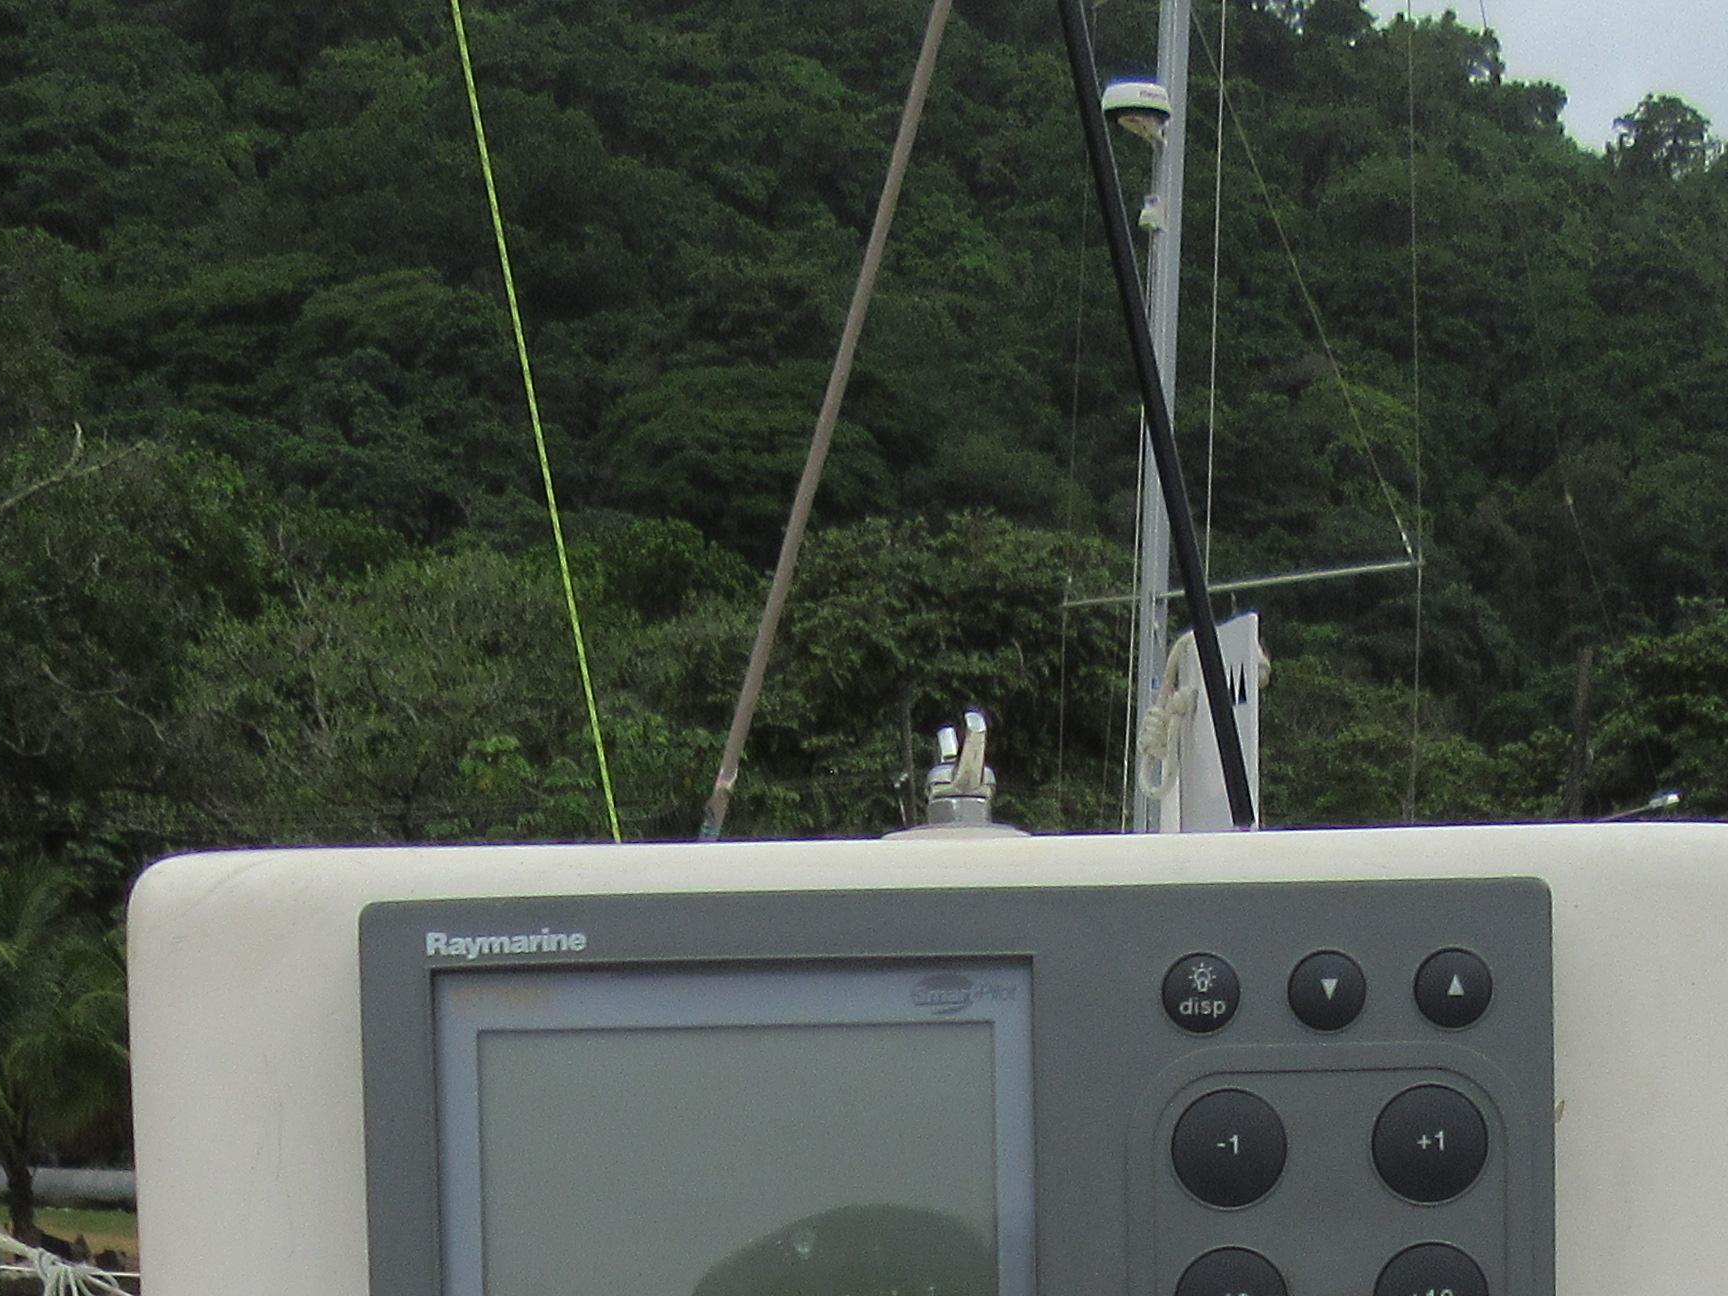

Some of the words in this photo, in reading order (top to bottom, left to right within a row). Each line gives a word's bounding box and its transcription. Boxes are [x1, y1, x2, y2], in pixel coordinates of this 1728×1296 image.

[426, 928, 588, 959] Raymarine
[1179, 997, 1226, 1018] disp
[1216, 1134, 1240, 1155] -1
[1416, 1130, 1446, 1151] +1
